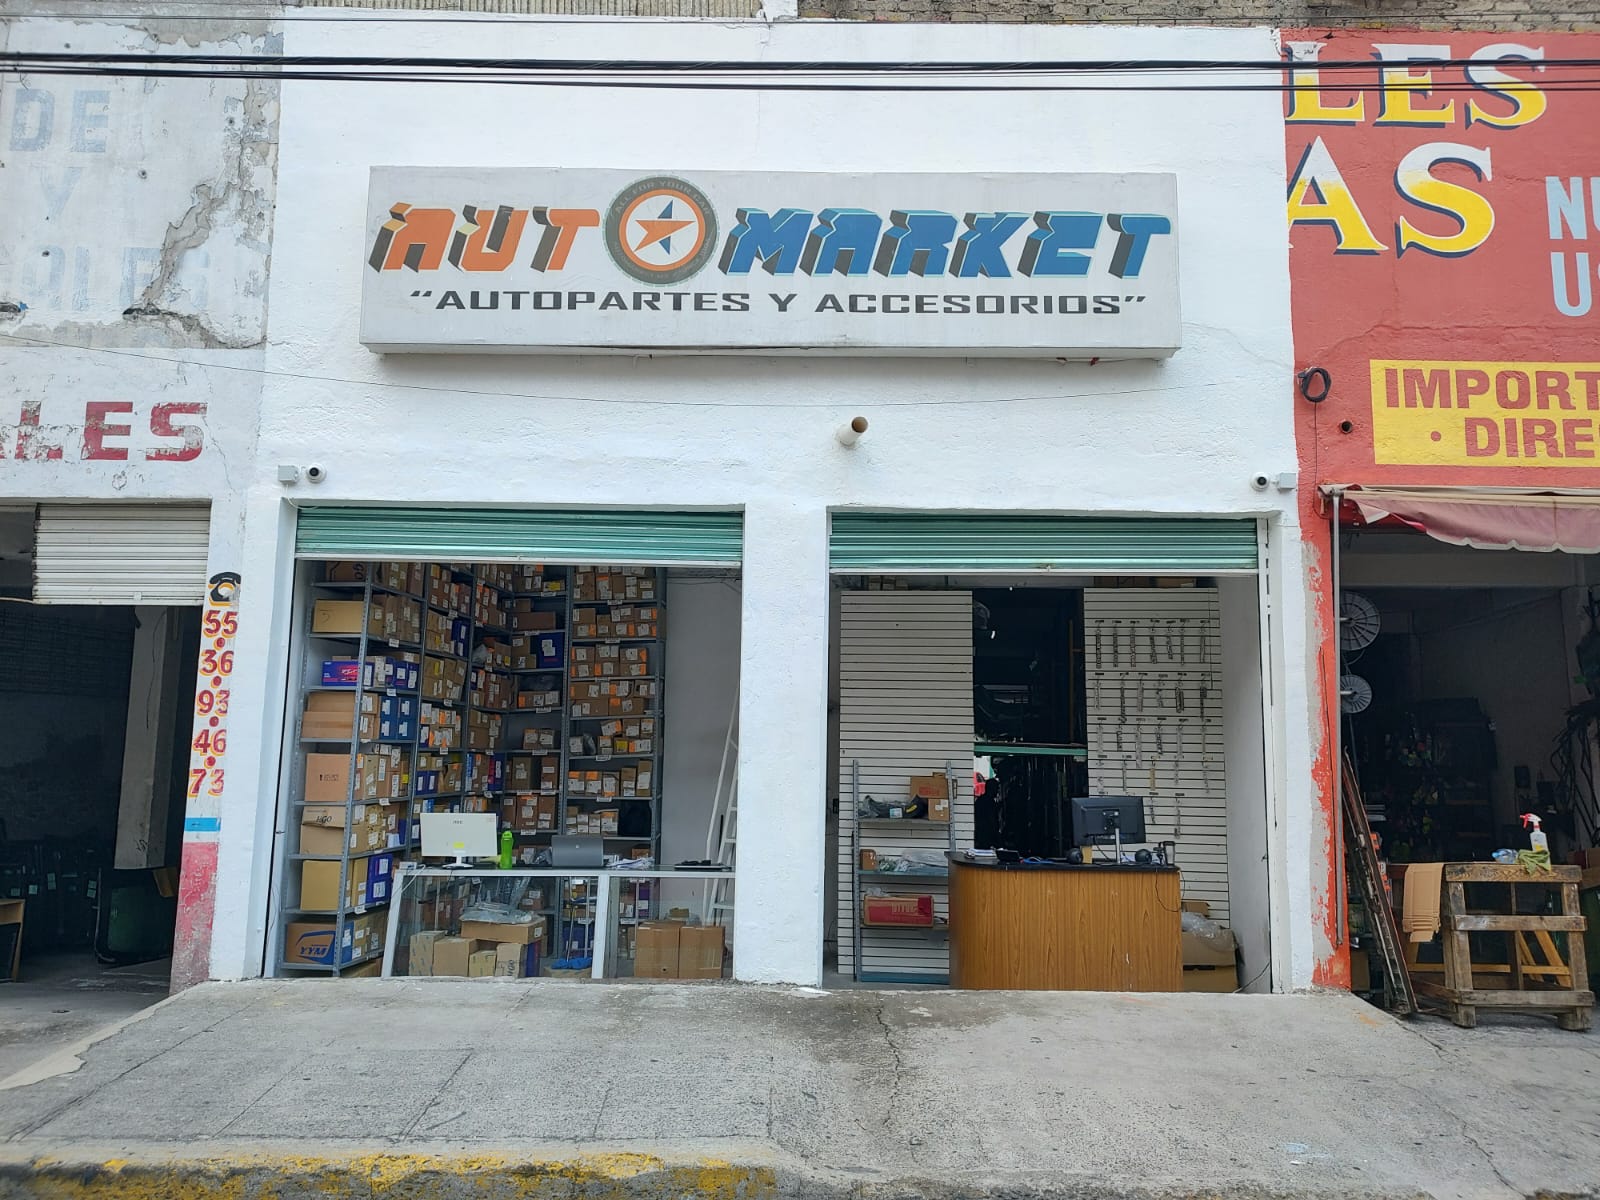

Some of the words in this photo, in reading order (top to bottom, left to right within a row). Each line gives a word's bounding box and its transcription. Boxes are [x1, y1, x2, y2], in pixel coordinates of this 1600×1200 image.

[1282, 41, 1547, 130] LES
[10, 88, 111, 153] DE
[1287, 136, 1496, 258] AS
[718, 208, 1172, 279] MARKET
[768, 293, 798, 312] Y
[0, 400, 208, 462] LES
[1464, 417, 1600, 458] DIRE
[203, 609, 238, 638] 55
[199, 649, 234, 677] 36
[196, 689, 230, 717] 93
[192, 729, 227, 757] 46
[187, 768, 225, 798] 73
